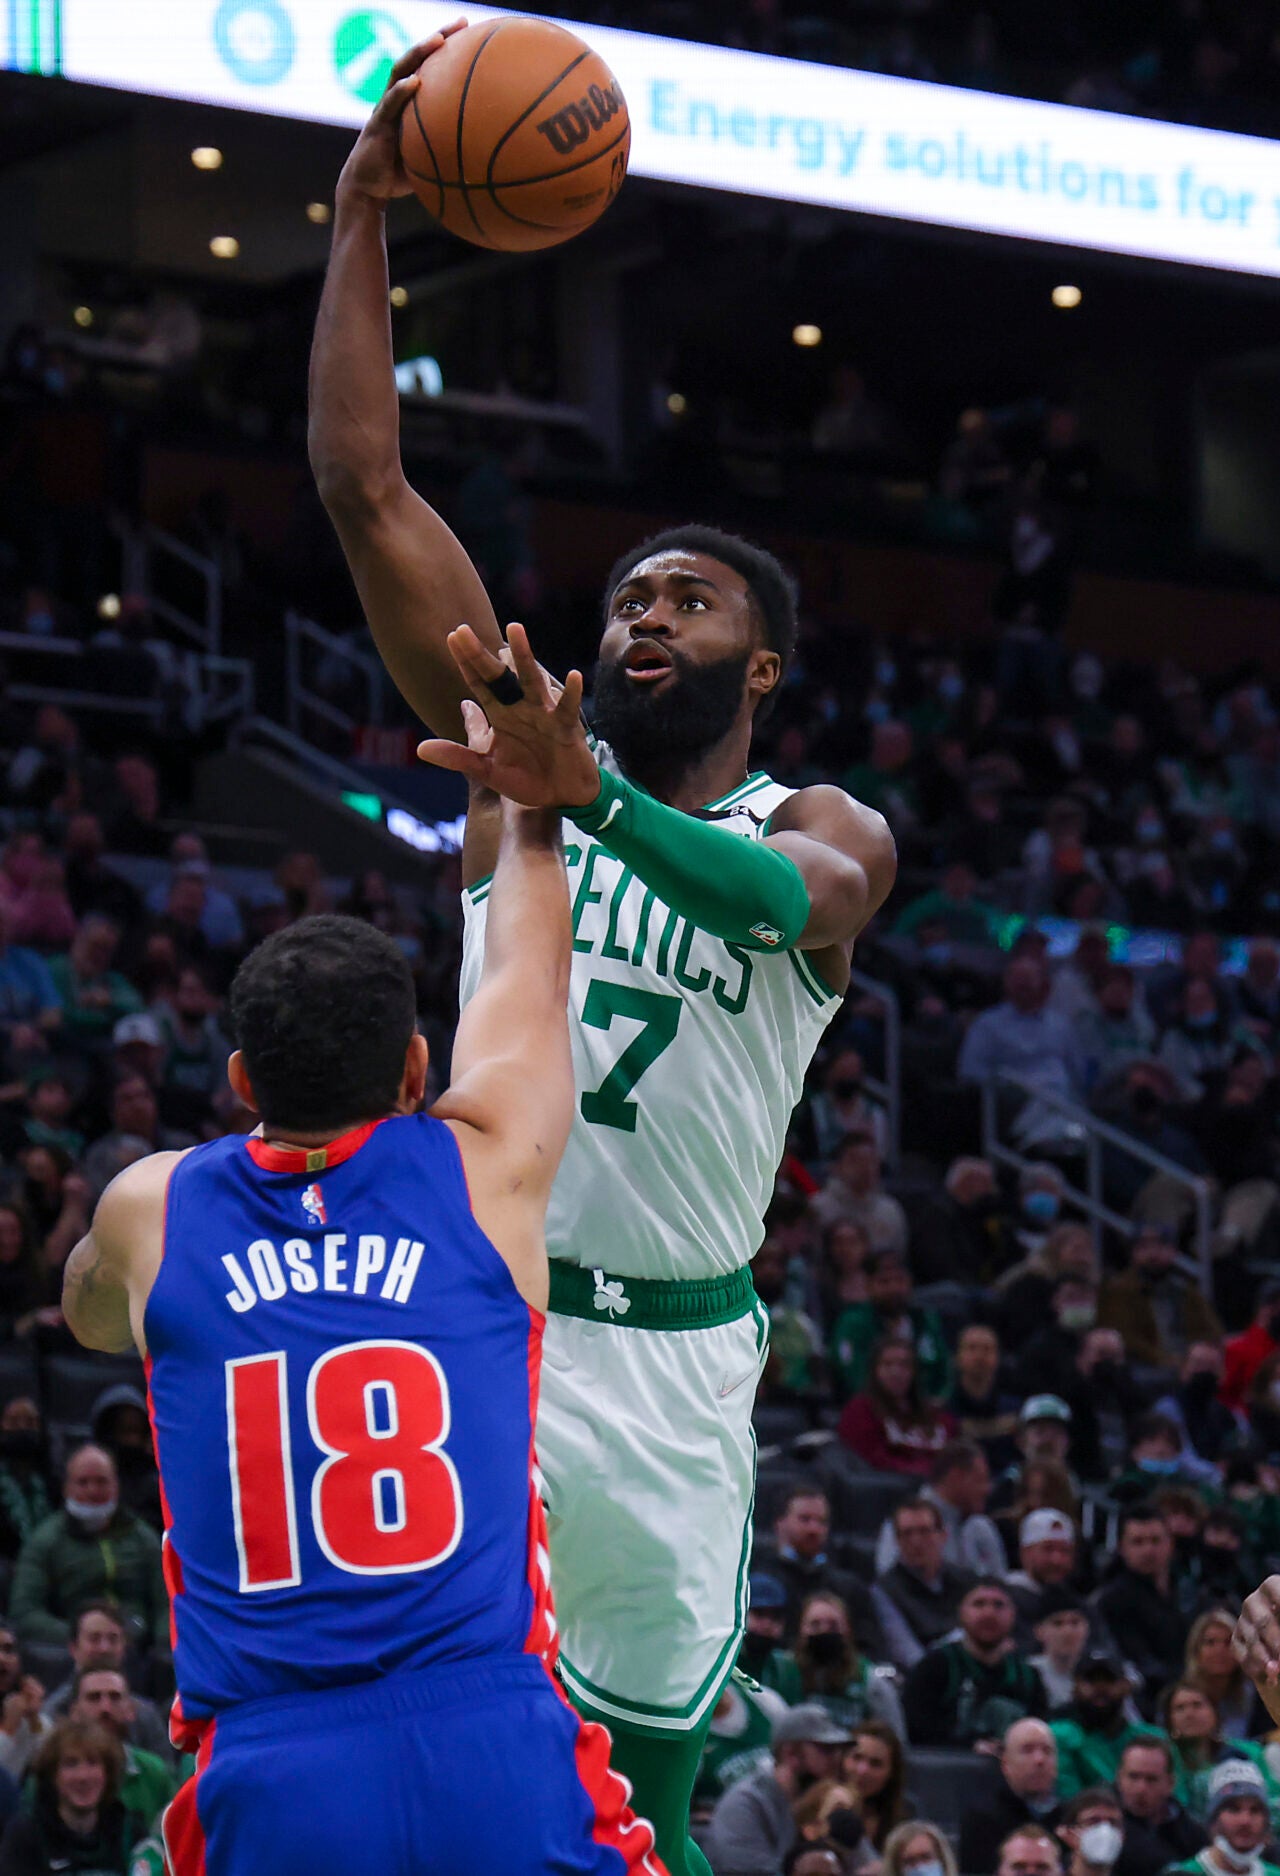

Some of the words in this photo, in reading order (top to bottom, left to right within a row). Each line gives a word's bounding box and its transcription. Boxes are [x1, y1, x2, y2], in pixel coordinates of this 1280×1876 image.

[648, 77, 864, 177] Energy
[882, 127, 1158, 210] solutions
[1177, 164, 1256, 227] for
[580, 978, 683, 1133] 7
[221, 1234, 425, 1313] JOSEPH
[225, 1339, 464, 1593] 18
